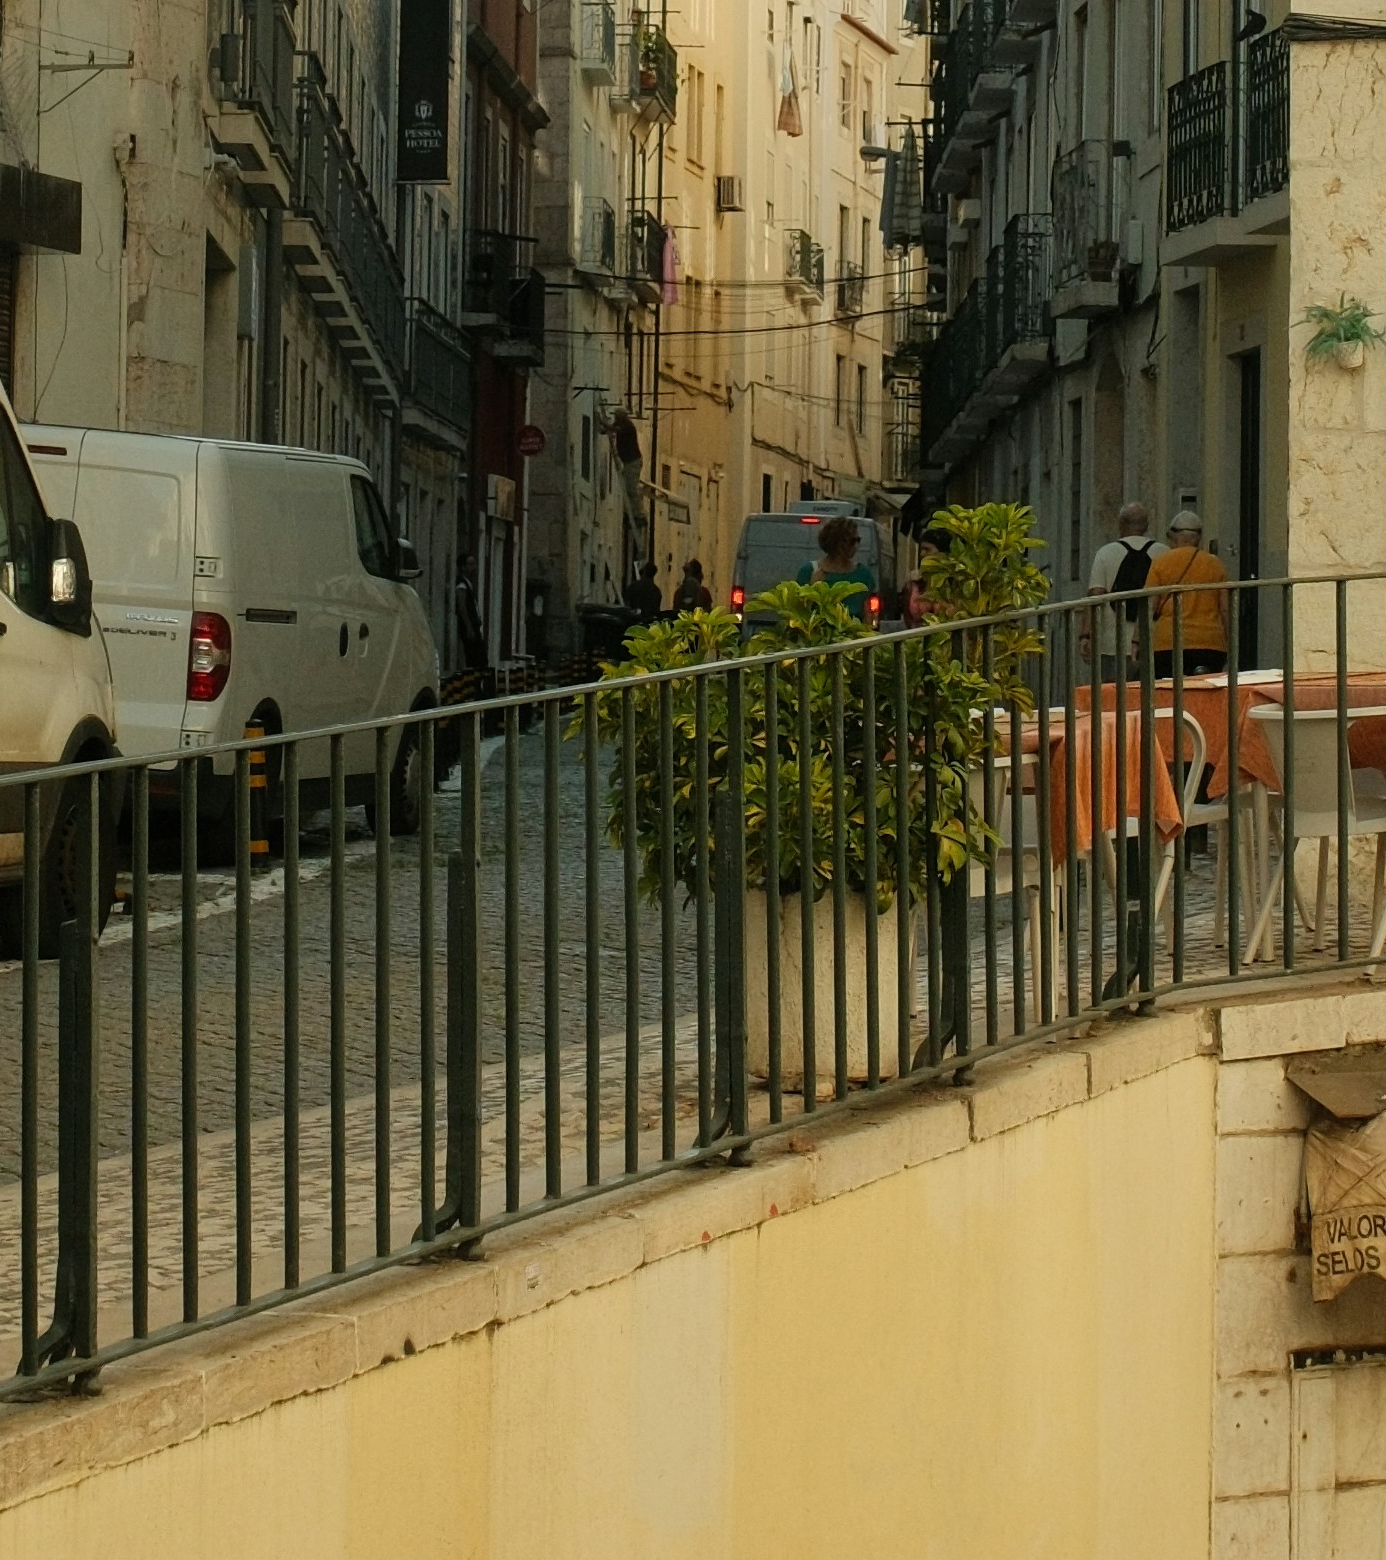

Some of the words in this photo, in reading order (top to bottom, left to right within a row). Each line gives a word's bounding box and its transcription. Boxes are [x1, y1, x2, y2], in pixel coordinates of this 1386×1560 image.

[405, 129, 442, 138] PESSOA
[406, 139, 441, 148] HOTEL
[1316, 1245, 1381, 1276] SELOS
